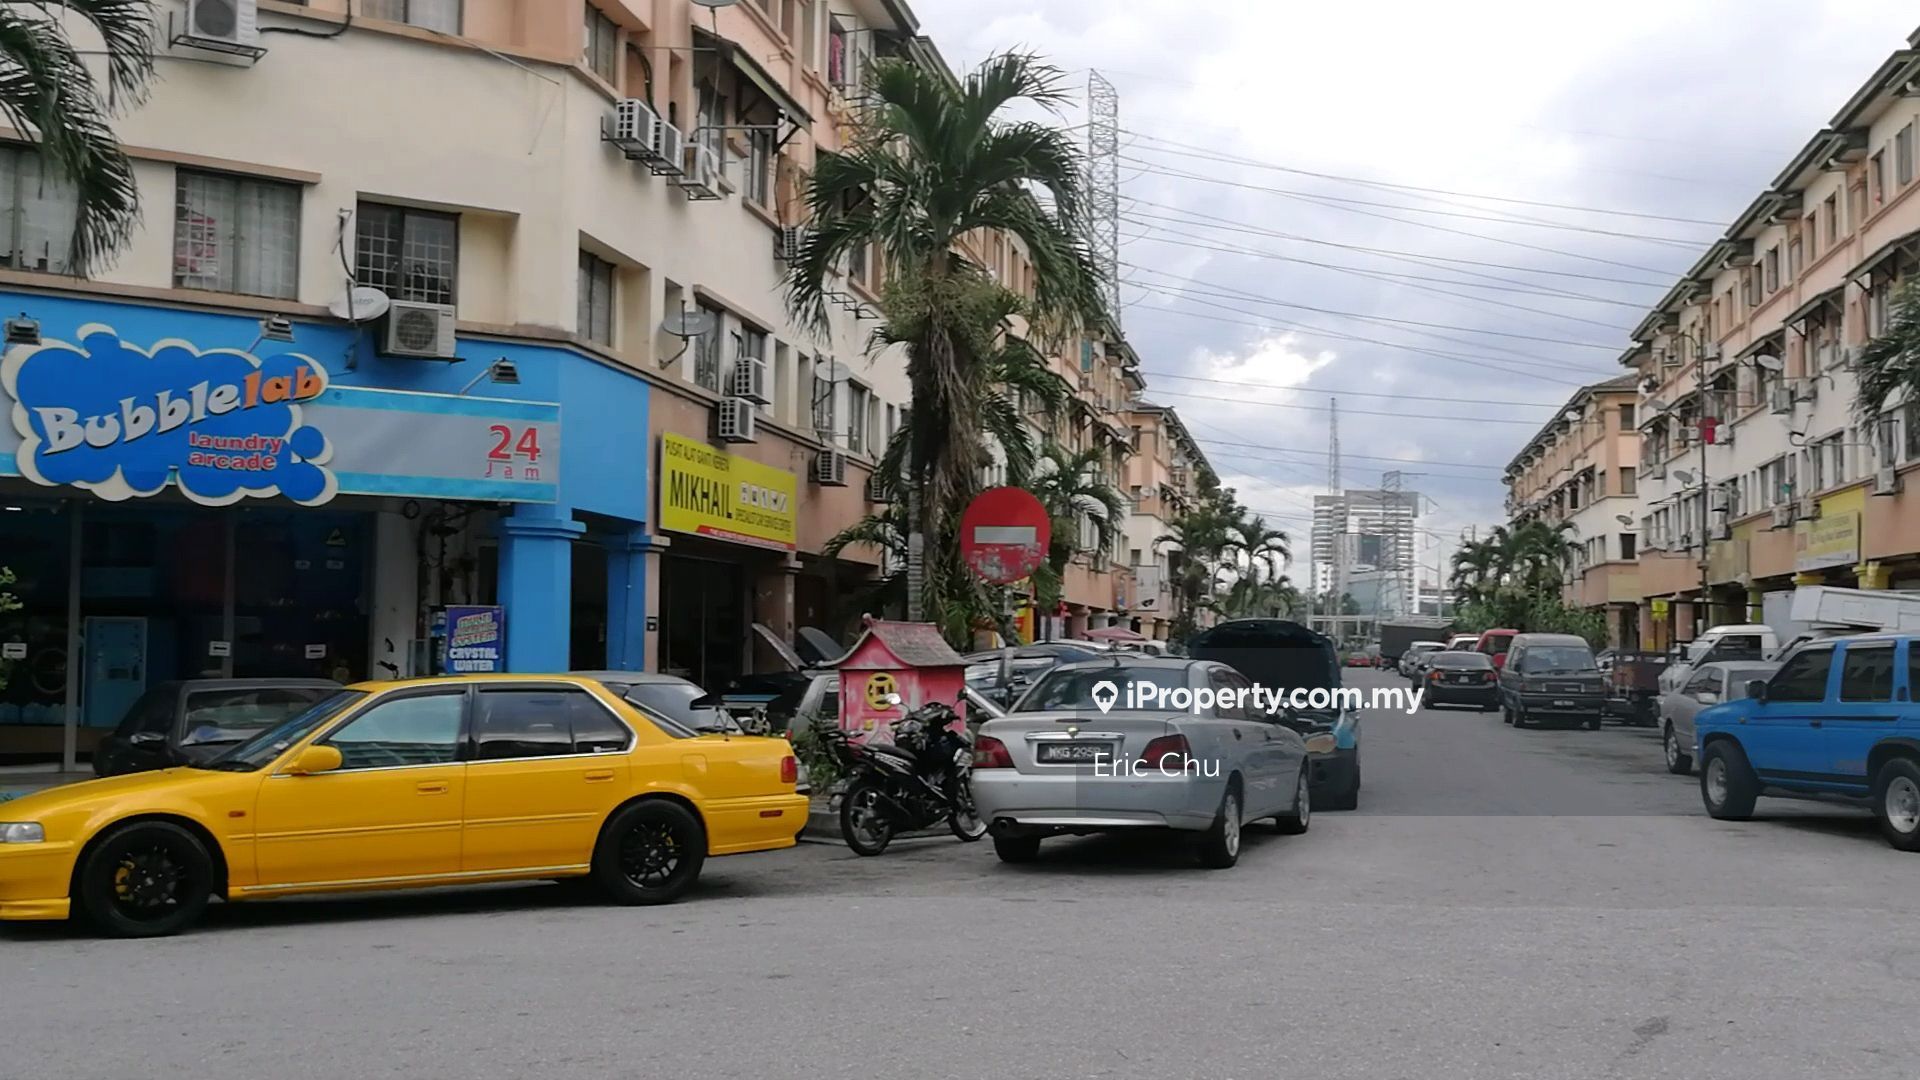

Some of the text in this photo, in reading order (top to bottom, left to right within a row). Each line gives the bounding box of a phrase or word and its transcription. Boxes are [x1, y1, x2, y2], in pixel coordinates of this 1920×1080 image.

[32, 367, 322, 455] Bubblelab
[188, 431, 283, 454] laundry
[487, 424, 541, 462] 24
[188, 450, 277, 471] arcade
[485, 461, 540, 480] Jam
[669, 469, 733, 519] MIKHAIL
[449, 647, 499, 659] CRYSTAL
[454, 659, 494, 671] WATER
